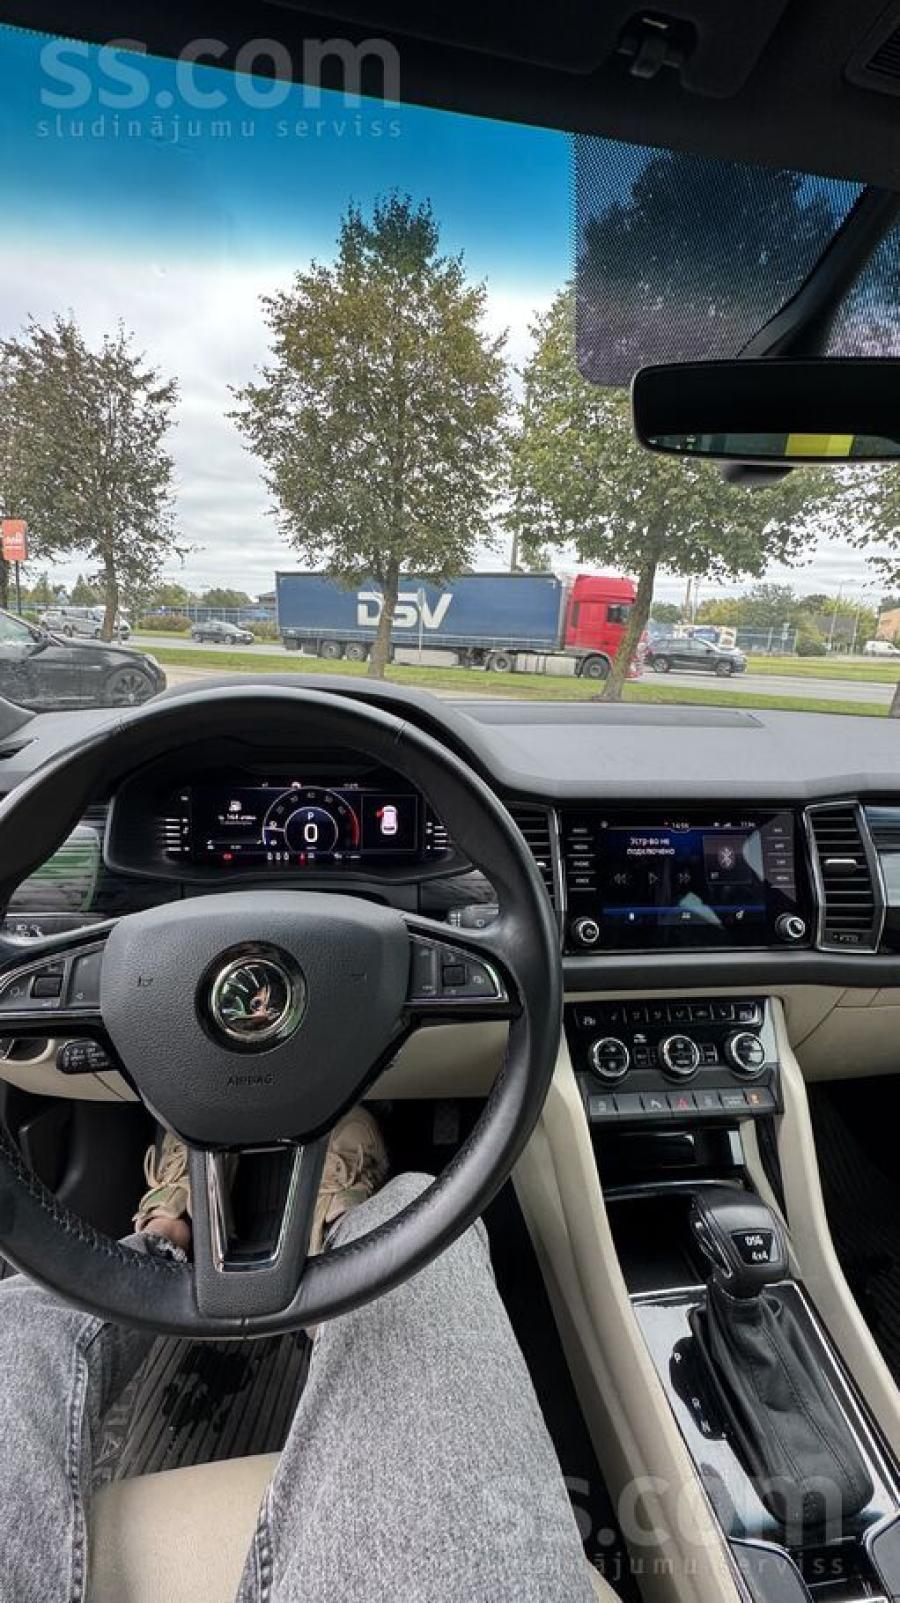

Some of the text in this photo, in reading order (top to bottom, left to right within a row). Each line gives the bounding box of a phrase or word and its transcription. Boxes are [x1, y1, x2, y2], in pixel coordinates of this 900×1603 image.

[357, 591, 453, 629] DSV
[307, 812, 315, 820] P
[304, 823, 318, 843] 0
[227, 1073, 276, 1086] AIRBAG
